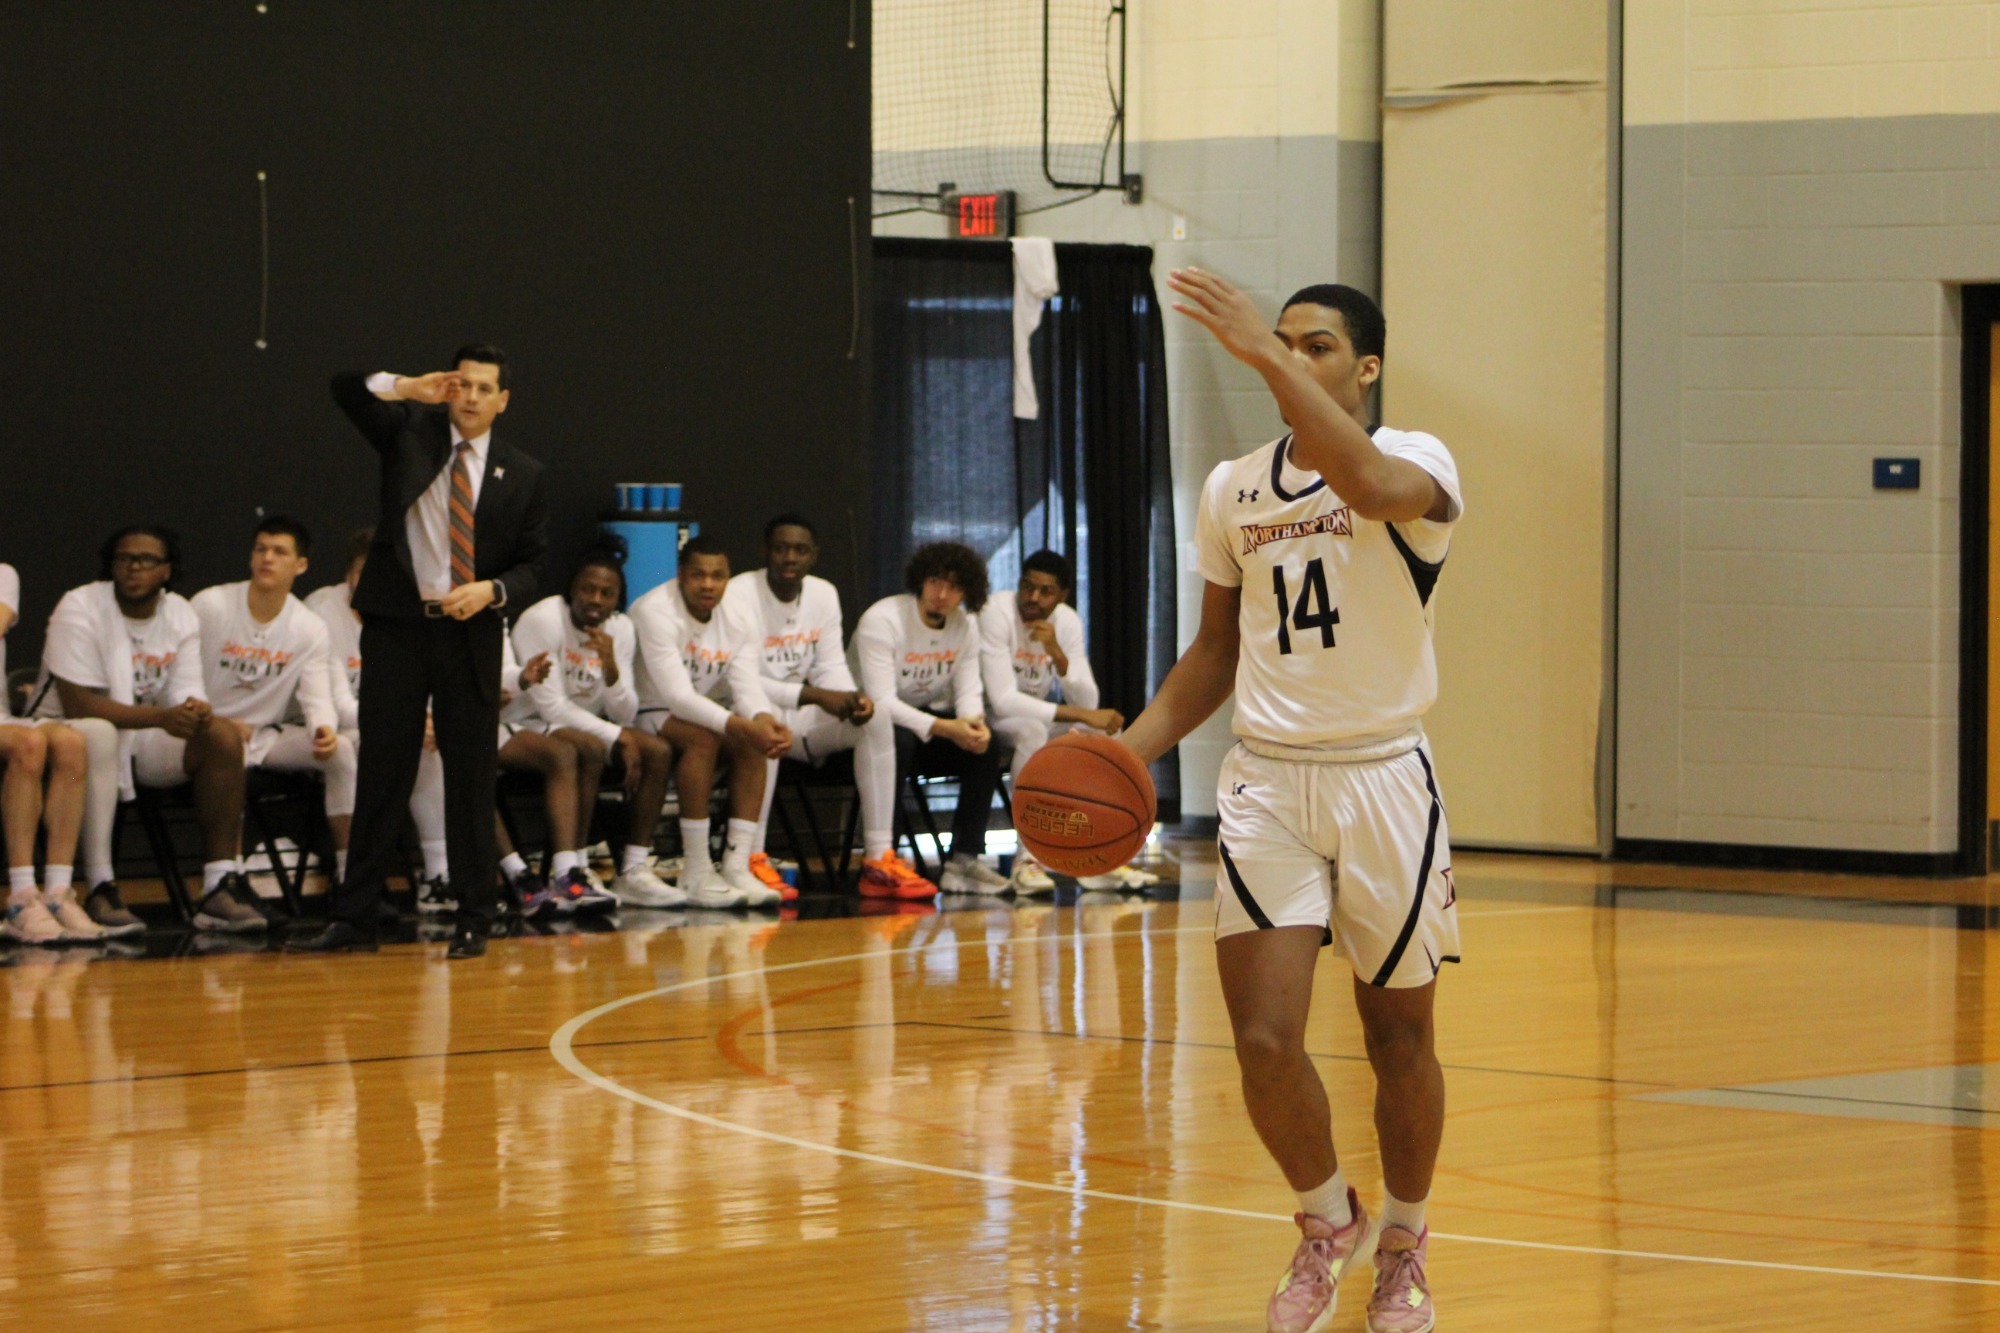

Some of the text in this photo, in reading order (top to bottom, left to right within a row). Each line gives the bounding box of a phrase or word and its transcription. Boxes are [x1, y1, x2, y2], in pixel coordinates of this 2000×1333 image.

[960, 194, 996, 236] EXIT
[1241, 506, 1353, 556] NORTHAMPTON
[1273, 557, 1340, 655] 14
[1021, 812, 1094, 838] LEGACY
